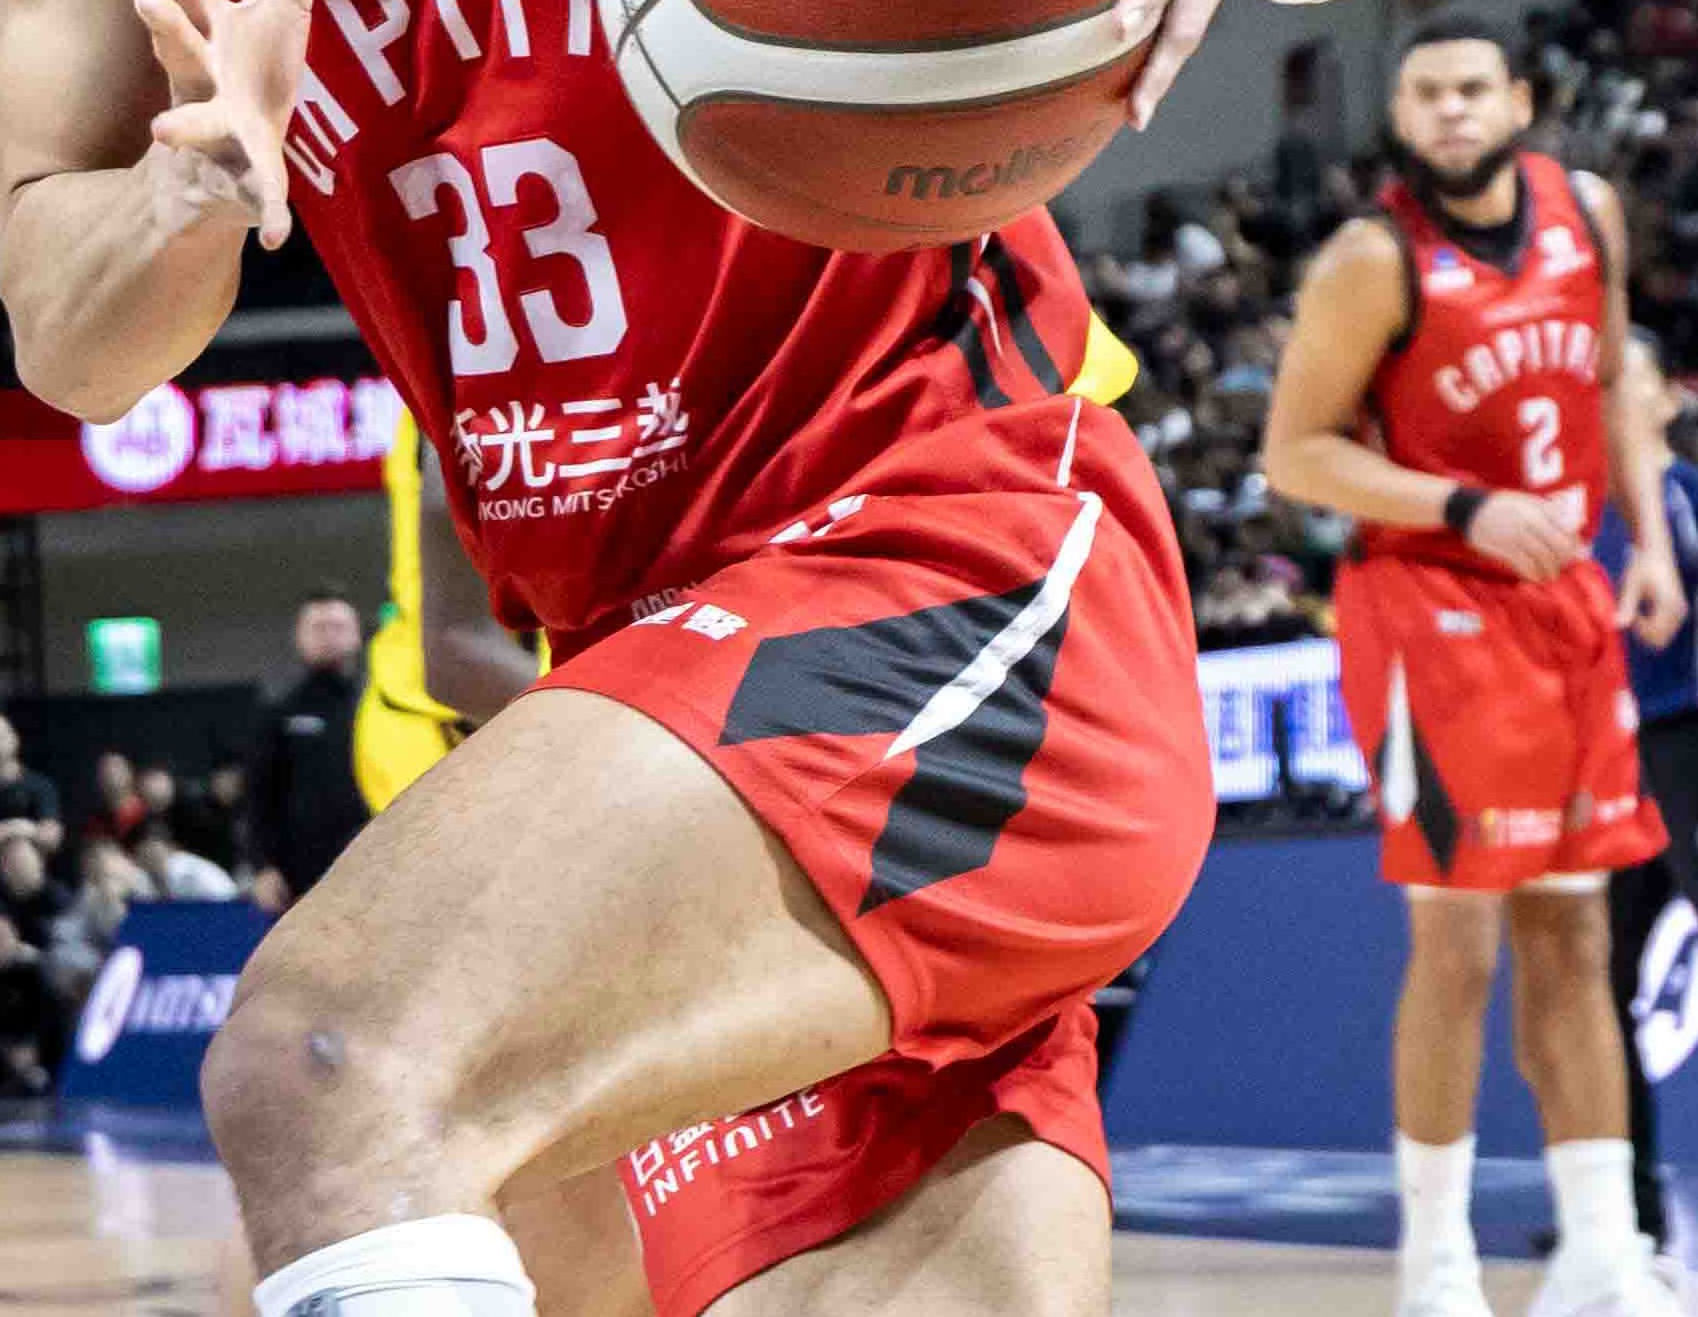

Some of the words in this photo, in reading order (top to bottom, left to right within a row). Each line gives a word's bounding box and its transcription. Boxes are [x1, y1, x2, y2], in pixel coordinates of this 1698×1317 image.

[387, 135, 630, 378] 33
[1433, 319, 1598, 414] CAPITA
[553, 452, 690, 516] MITSKOSHI
[1517, 396, 1564, 490] 2
